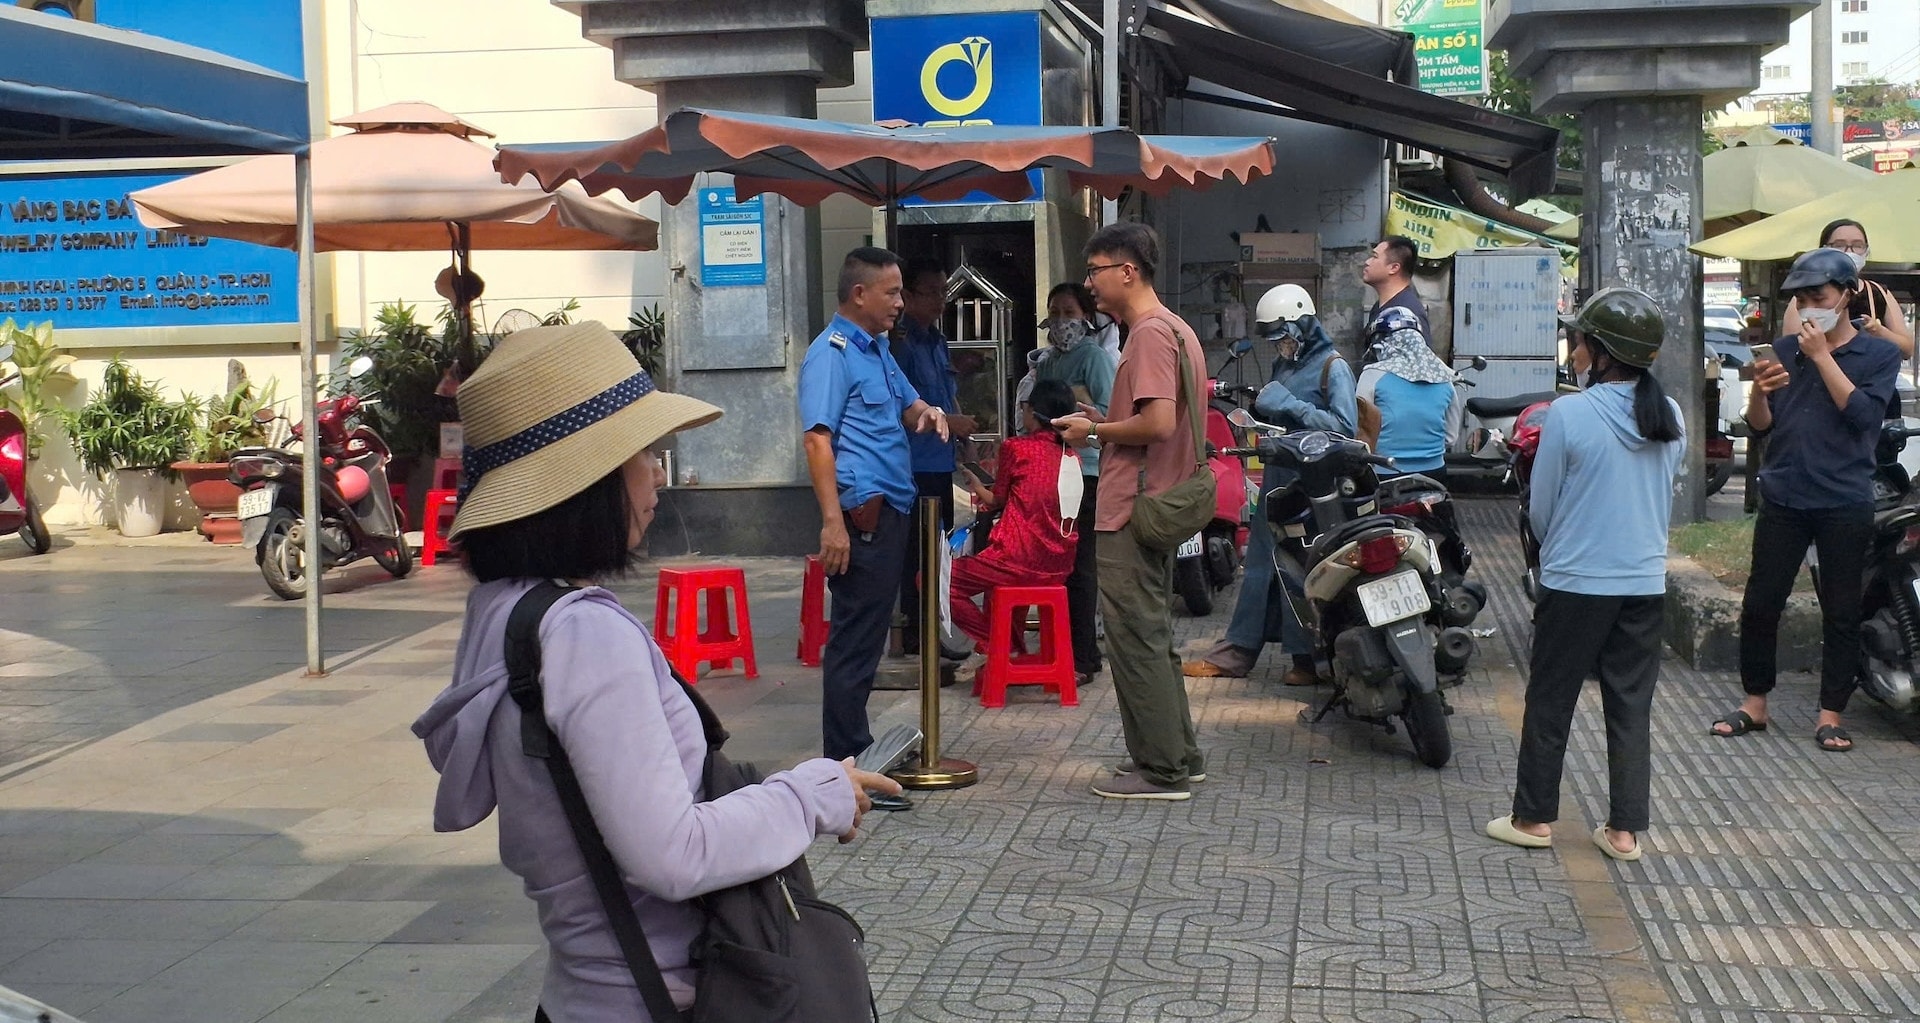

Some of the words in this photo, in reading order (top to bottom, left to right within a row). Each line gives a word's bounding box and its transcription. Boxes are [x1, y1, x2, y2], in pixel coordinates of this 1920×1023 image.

[1443, 31, 1467, 48] SỐ
[1470, 35, 1477, 46] 1
[1435, 53, 1459, 65] TẤM
[1420, 68, 1437, 79] HỊT
[1440, 65, 1479, 77] NƯỚNG
[62, 199, 101, 225] BẠC
[0, 234, 57, 252] WELRY
[61, 231, 138, 251] COMPANY
[34, 279, 67, 294] KHAI
[78, 274, 134, 292] PHƯỜNG
[138, 277, 146, 291] 5
[156, 272, 195, 292] QUẬN
[200, 275, 208, 289] 3
[218, 273, 271, 289] TP.HCM
[119, 294, 158, 309] Email:
[161, 292, 269, 310] info@sjc.com.vn
